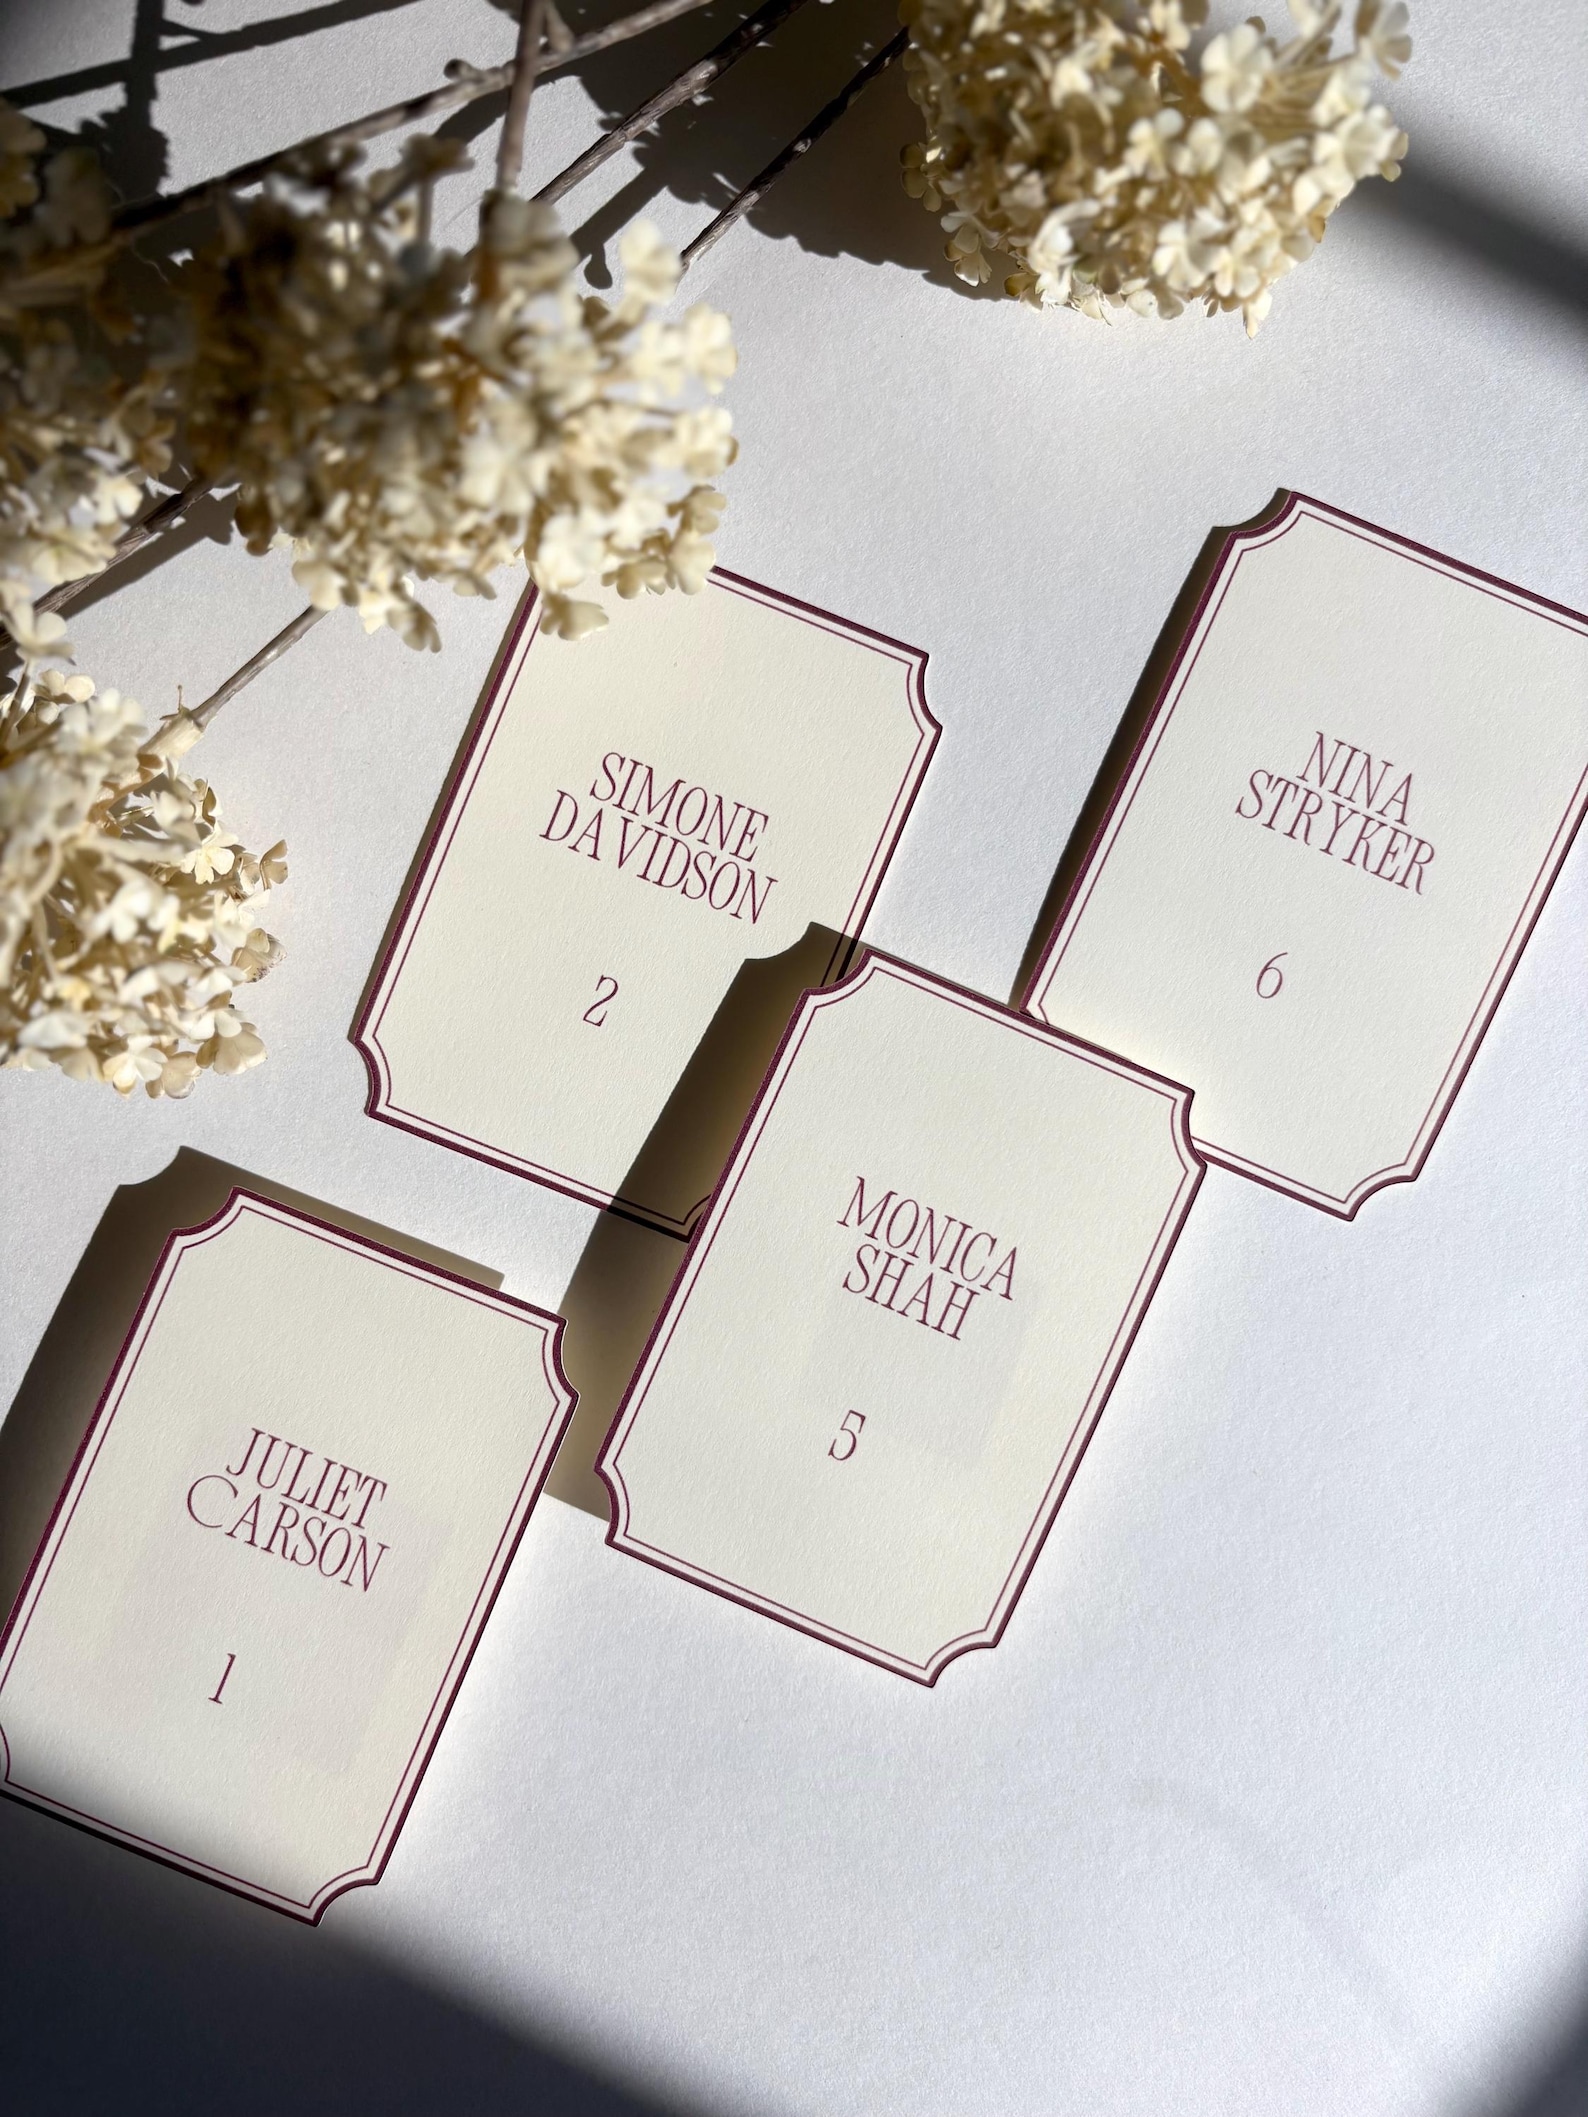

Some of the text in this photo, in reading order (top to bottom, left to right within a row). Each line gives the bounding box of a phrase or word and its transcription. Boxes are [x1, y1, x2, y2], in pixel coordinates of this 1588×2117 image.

[589, 752, 769, 862] SIMONE
[1296, 730, 1413, 826] NINA
[539, 789, 778, 924] DAVIDSON
[1235, 769, 1435, 895] STRYKER
[582, 974, 618, 1027] 2
[1256, 951, 1288, 999] 6
[836, 1176, 1017, 1301] MONICA
[842, 1243, 980, 1341] SHAH
[226, 1427, 388, 1529] JULIET
[828, 1409, 866, 1461] 5
[187, 1474, 391, 1592] CARSON
[208, 1652, 236, 1705] 1
